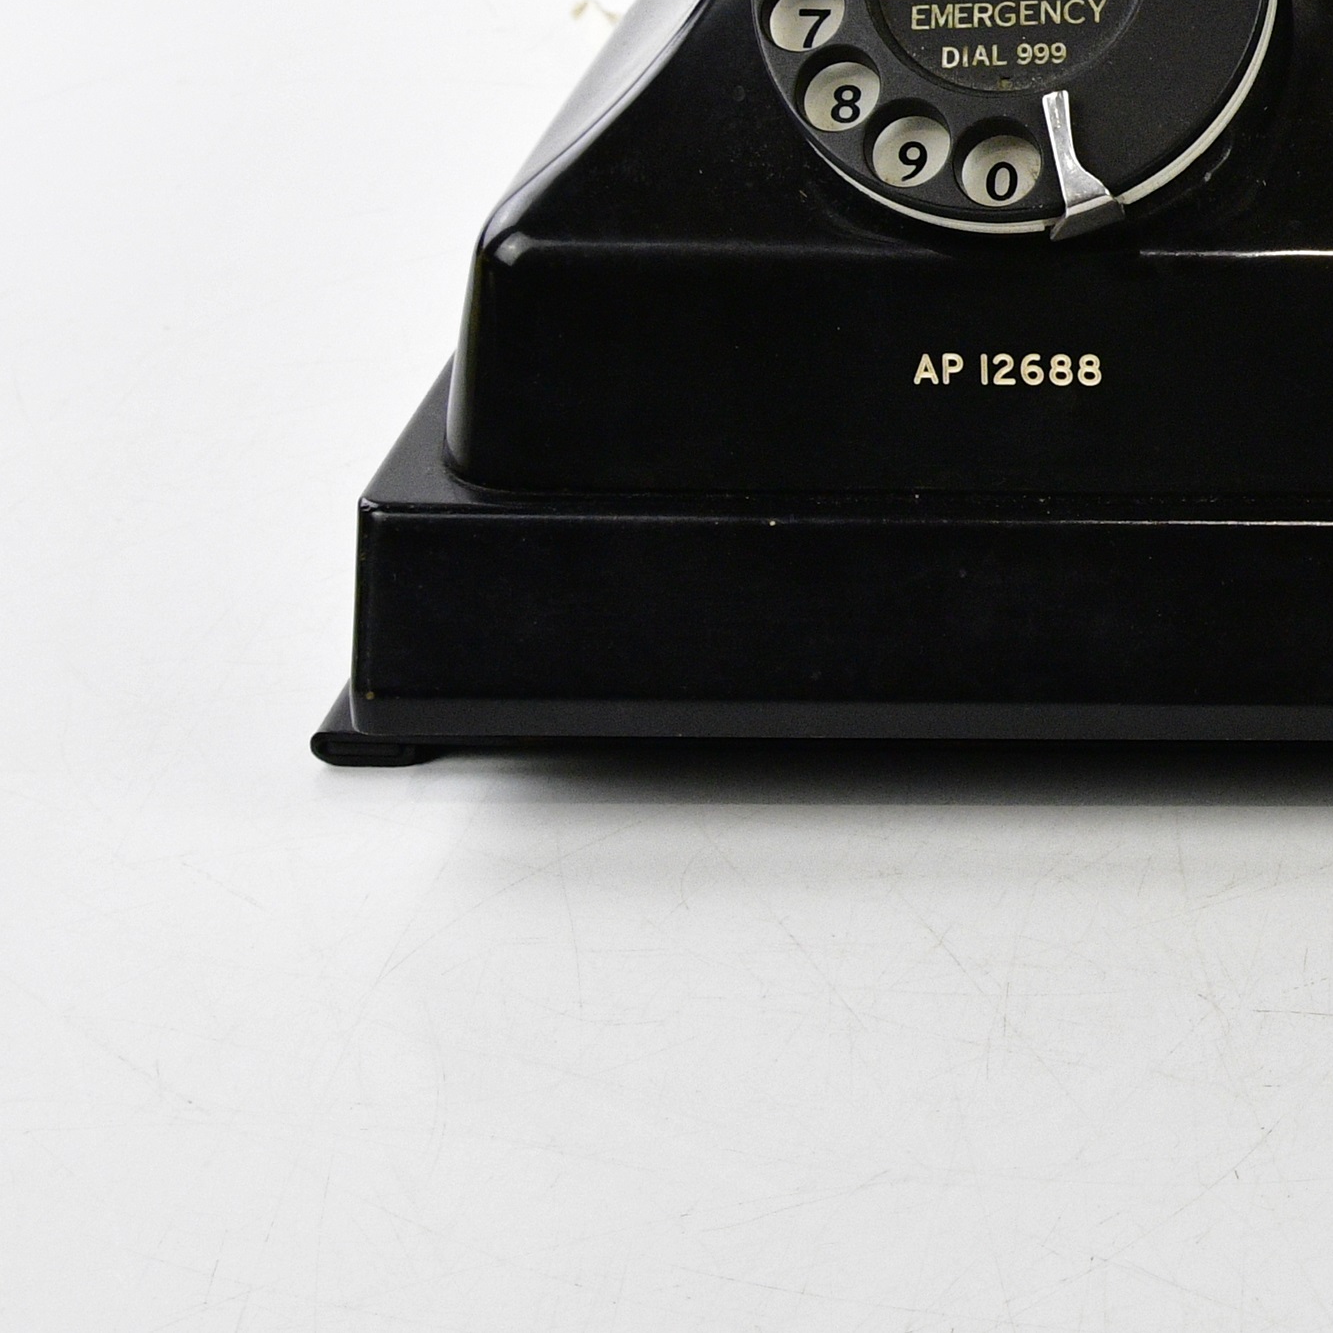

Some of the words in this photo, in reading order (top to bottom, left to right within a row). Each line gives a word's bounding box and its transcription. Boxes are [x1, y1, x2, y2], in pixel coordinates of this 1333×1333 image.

[798, 8, 831, 49] 7
[942, 44, 1008, 68] DIAL
[1016, 42, 1067, 65] 999
[830, 84, 862, 123] 8
[898, 141, 928, 182] 9
[986, 161, 1018, 201] 0
[913, 353, 964, 385] AP
[980, 353, 1102, 387] 12688
